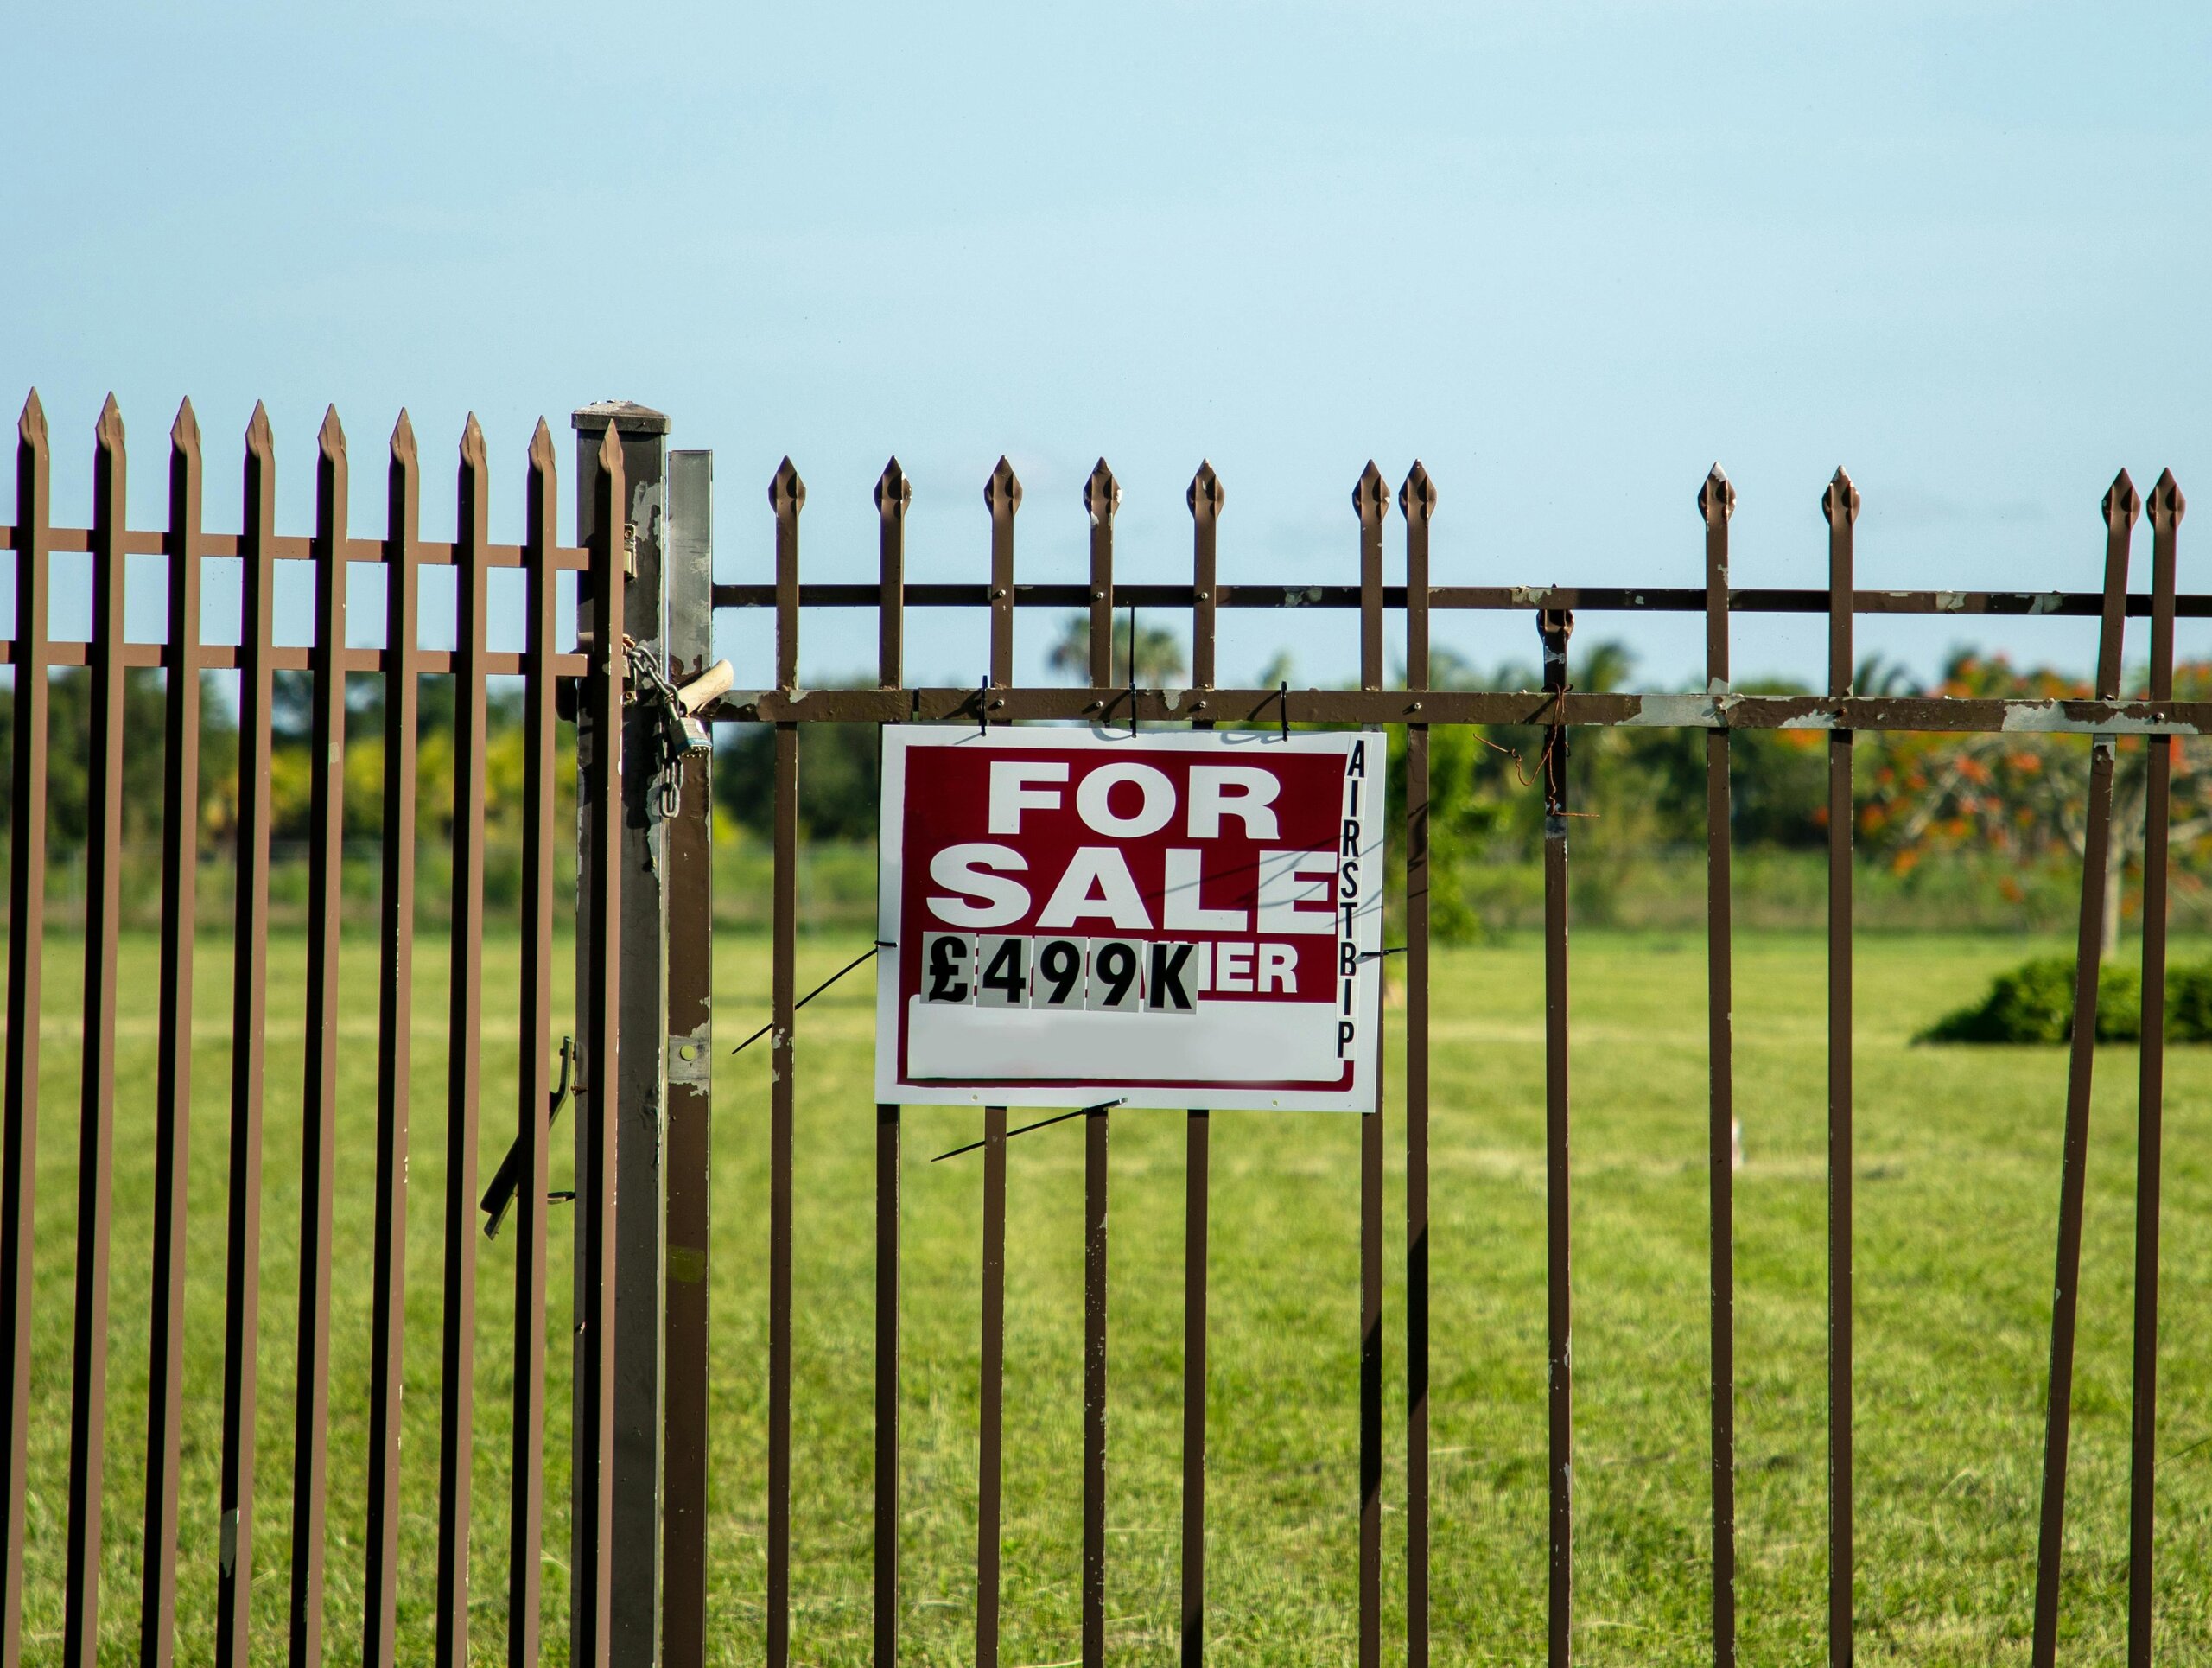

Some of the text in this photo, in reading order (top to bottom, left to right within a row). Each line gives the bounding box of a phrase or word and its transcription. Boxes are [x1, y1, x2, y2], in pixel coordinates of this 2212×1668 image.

[988, 761, 1281, 839] FOR
[926, 843, 1338, 934] SALE
[928, 935, 1195, 1009] £499K
